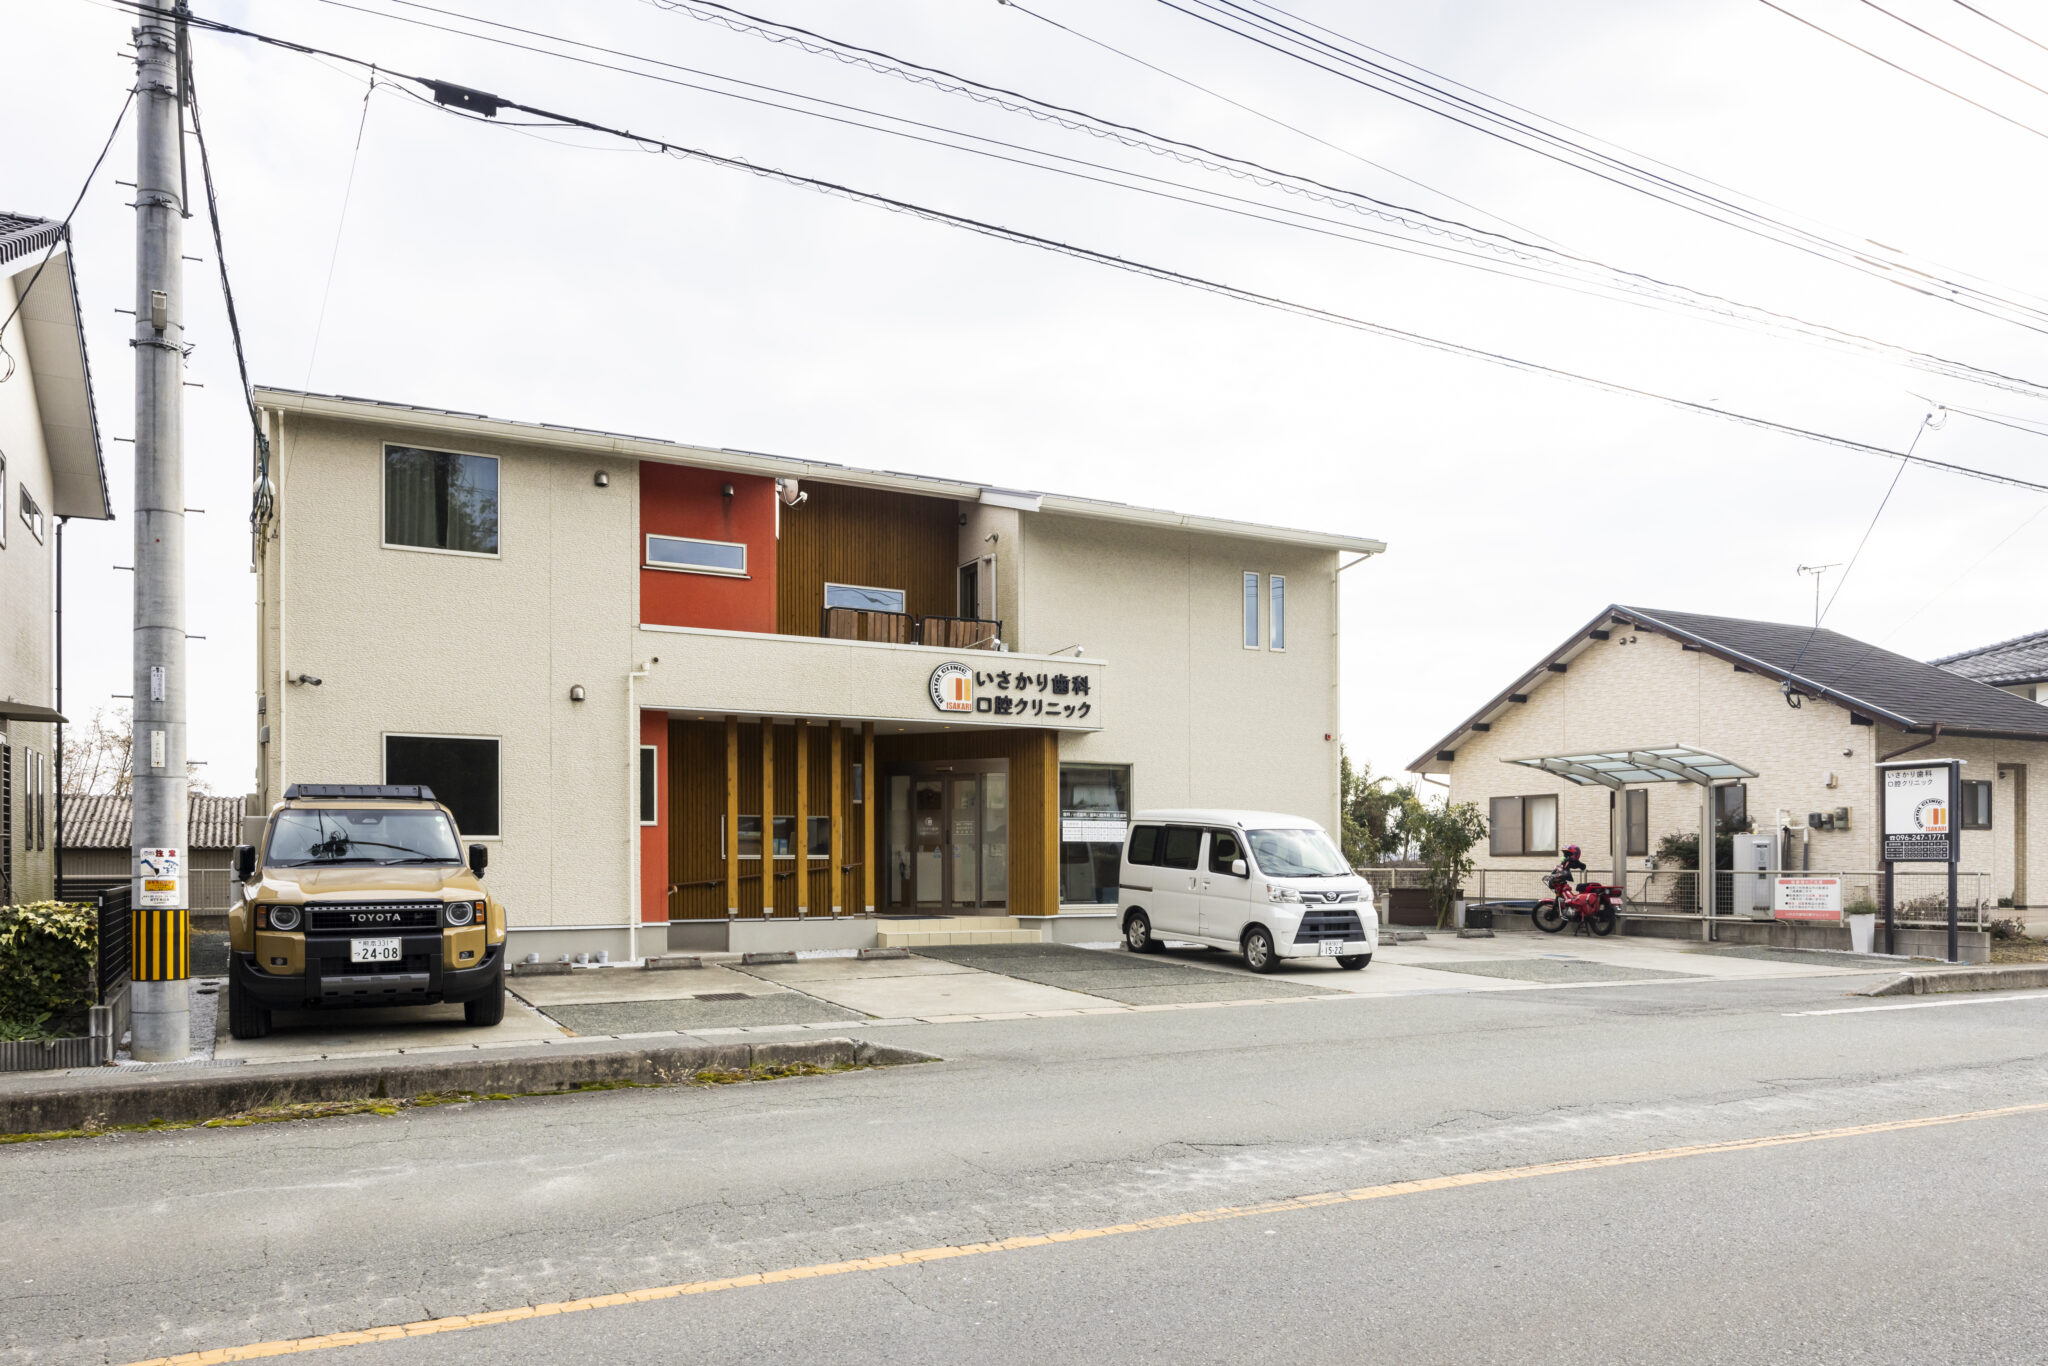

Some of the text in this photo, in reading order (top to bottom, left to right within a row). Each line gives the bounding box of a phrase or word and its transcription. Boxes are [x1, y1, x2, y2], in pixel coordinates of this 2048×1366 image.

[933, 664, 968, 704] DENTAL CLINIC
[976, 670, 1091, 696] いさかり歯科
[946, 702, 972, 711] ISAKARI
[976, 695, 1092, 719] 口腔クリニック
[1887, 770, 1932, 779] いさかり歯科
[1887, 779, 1933, 788] 口腔クリニック
[349, 913, 401, 922] TOYOTA
[362, 947, 398, 960] 24-08
